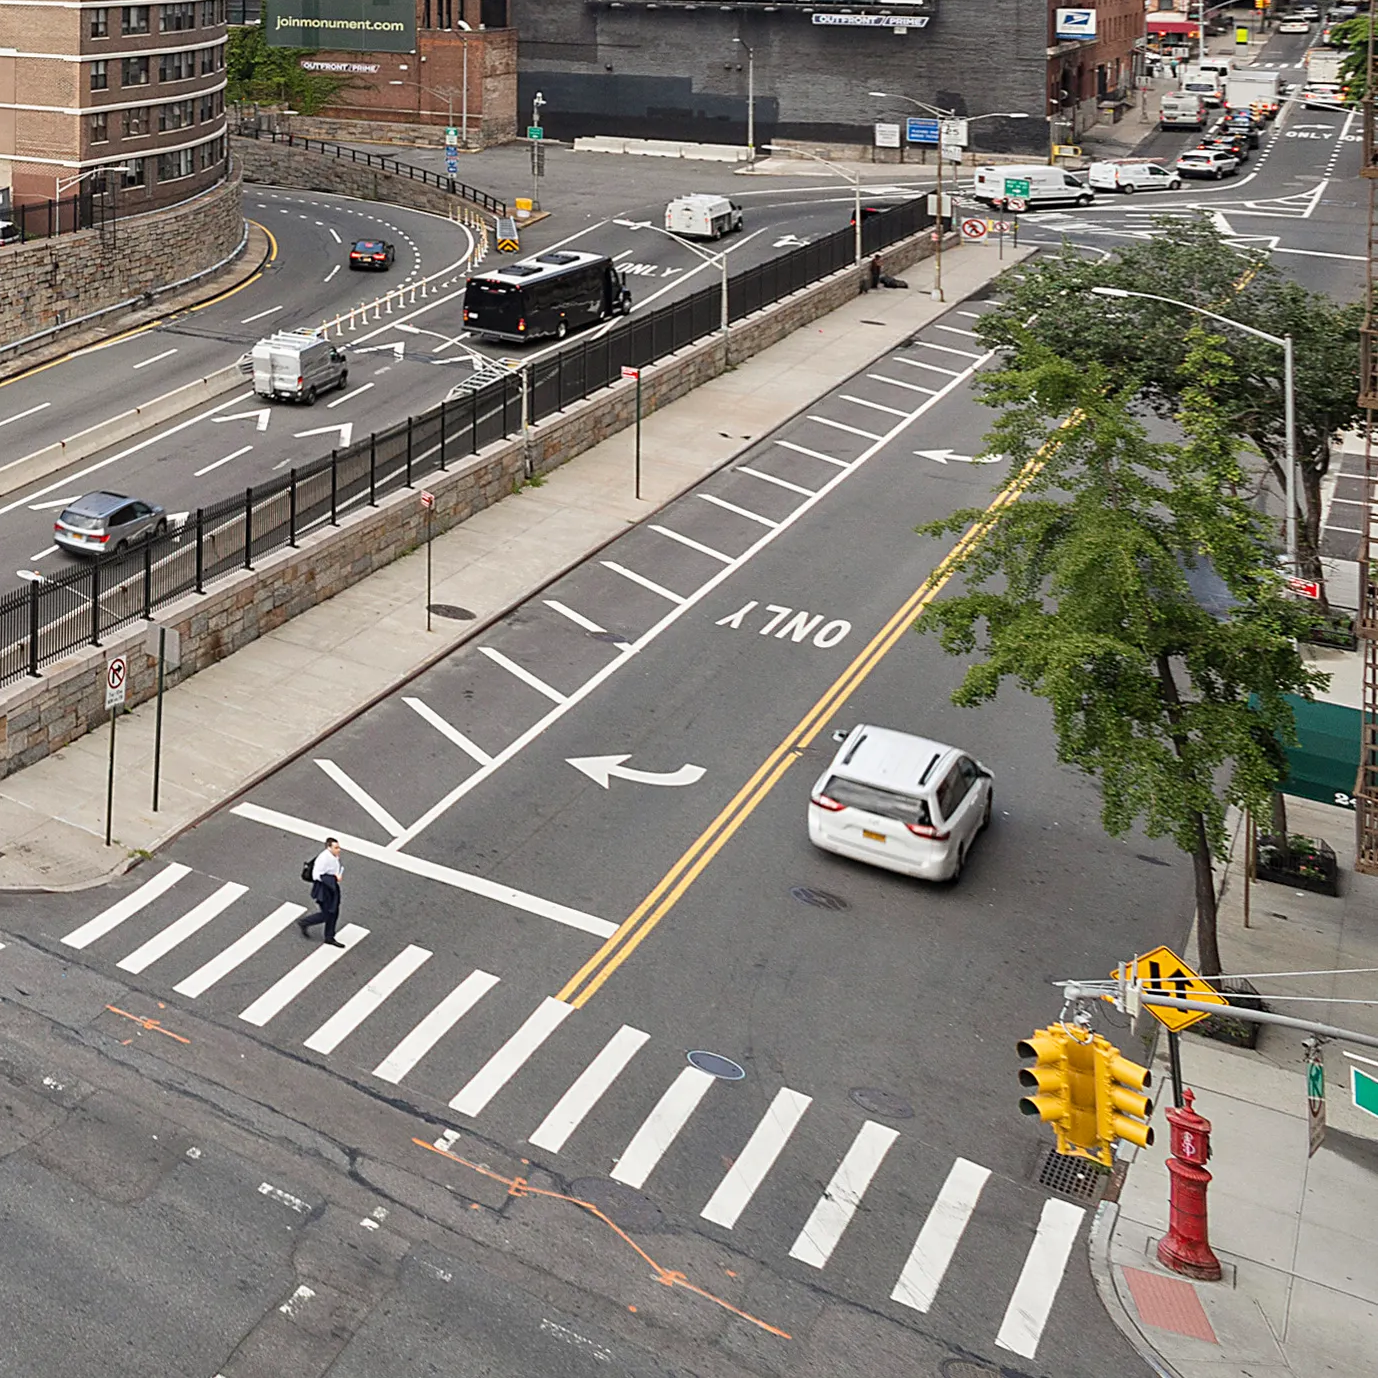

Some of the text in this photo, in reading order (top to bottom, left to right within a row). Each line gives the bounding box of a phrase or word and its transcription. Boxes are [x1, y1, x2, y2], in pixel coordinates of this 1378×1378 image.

[275, 15, 404, 31] joinmonument.com
[820, 15, 919, 26] OUTFRONT PRIME
[303, 62, 375, 72] OUTFRONT PRIME
[1285, 130, 1333, 140] ONLY
[614, 262, 684, 278] ONLY
[714, 600, 852, 649] ONLY
